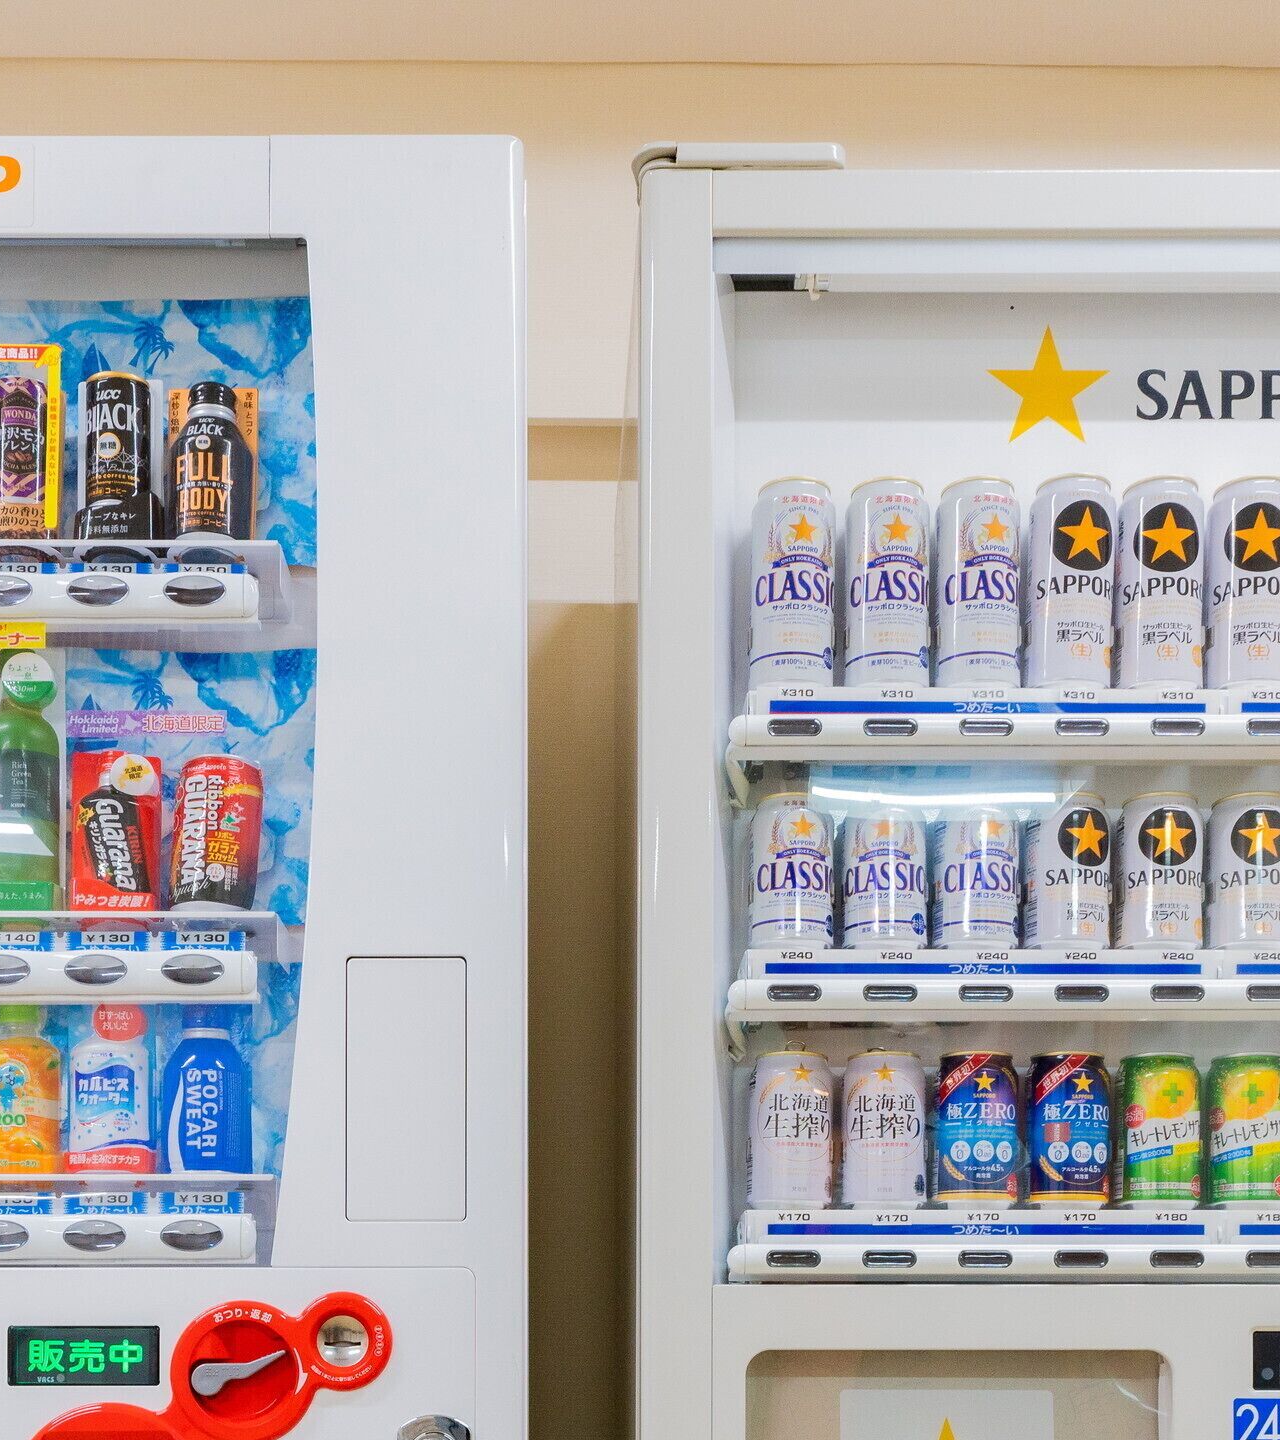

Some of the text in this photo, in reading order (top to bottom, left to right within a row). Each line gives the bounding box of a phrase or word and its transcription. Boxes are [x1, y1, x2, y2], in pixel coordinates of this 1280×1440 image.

[4, 409, 37, 420] WONDA
[86, 403, 141, 437] BLACK
[186, 423, 223, 436] BLACK
[176, 452, 233, 483] FULL
[179, 488, 228, 512] BODY
[788, 545, 818, 553] SAPPORO
[882, 545, 912, 553] SAPPORO
[881, 690, 914, 698] ¥310
[1064, 691, 1094, 699] ¥310
[70, 714, 119, 726] Hokkaido
[142, 716, 224, 732] 北海道限定
[82, 724, 118, 734] Limited
[208, 775, 224, 830] Ribbon
[180, 775, 207, 884] GUARANA
[86, 934, 130, 943] ¥130
[880, 952, 912, 960] ¥240
[1065, 952, 1096, 960] ¥240
[78, 1076, 129, 1092] カルピス
[186, 1068, 201, 1150] SWEAT
[769, 1094, 828, 1113] 北海道
[854, 1094, 916, 1113] 北海道
[946, 1102, 1016, 1120] 極ZERO
[201, 1068, 218, 1158] POCARI
[763, 1113, 831, 1139] 生搾り
[851, 1113, 920, 1140] 生搾り
[179, 1194, 223, 1203] ¥130
[876, 1214, 909, 1222] ¥170
[1064, 1213, 1096, 1221] ¥170
[213, 1308, 272, 1323] おつり・返却
[27, 1339, 143, 1373] 販売中
